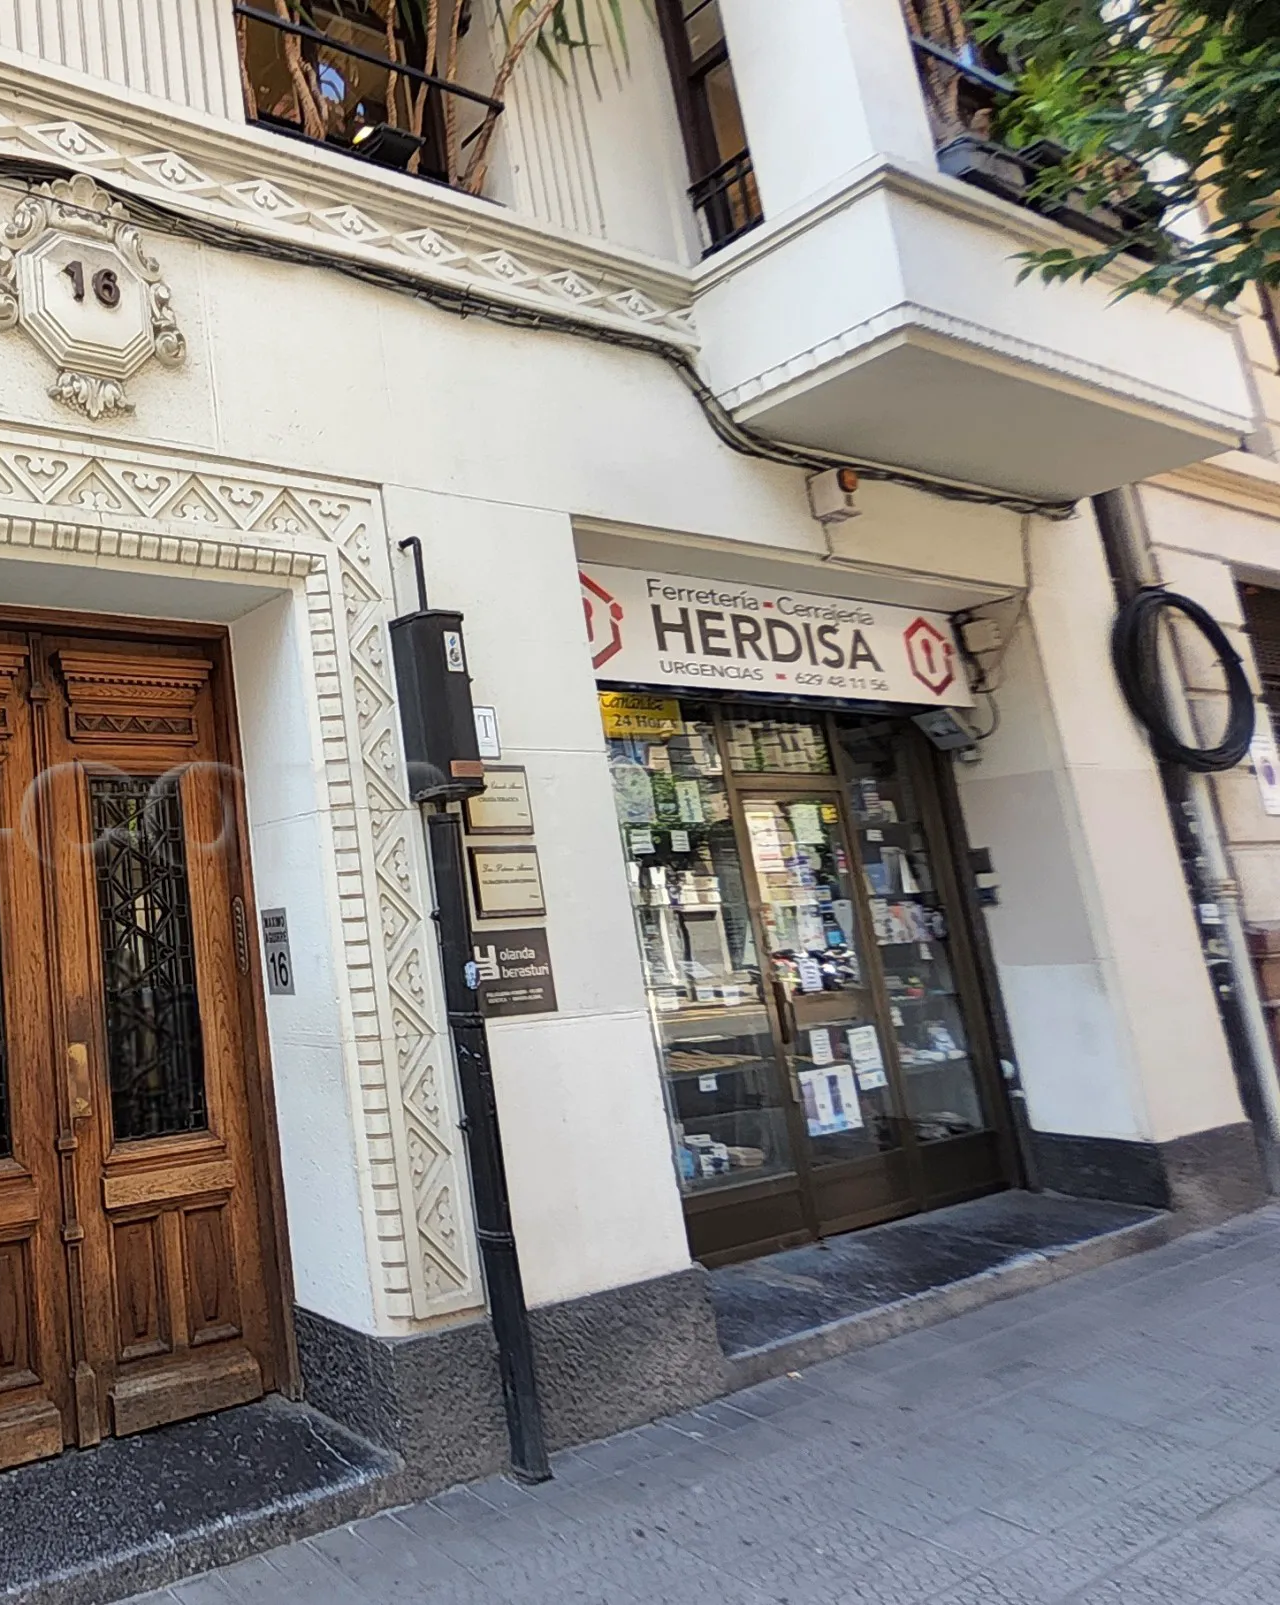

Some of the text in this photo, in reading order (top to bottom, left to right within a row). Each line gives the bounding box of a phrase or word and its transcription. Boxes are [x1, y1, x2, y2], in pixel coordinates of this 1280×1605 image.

[61, 260, 121, 309] 16
[646, 578, 875, 626] Ferretería Cerrajería
[650, 603, 884, 672] HERDISA
[659, 660, 764, 681] URGENCIAS
[477, 714, 494, 739] T
[269, 951, 289, 987] 16
